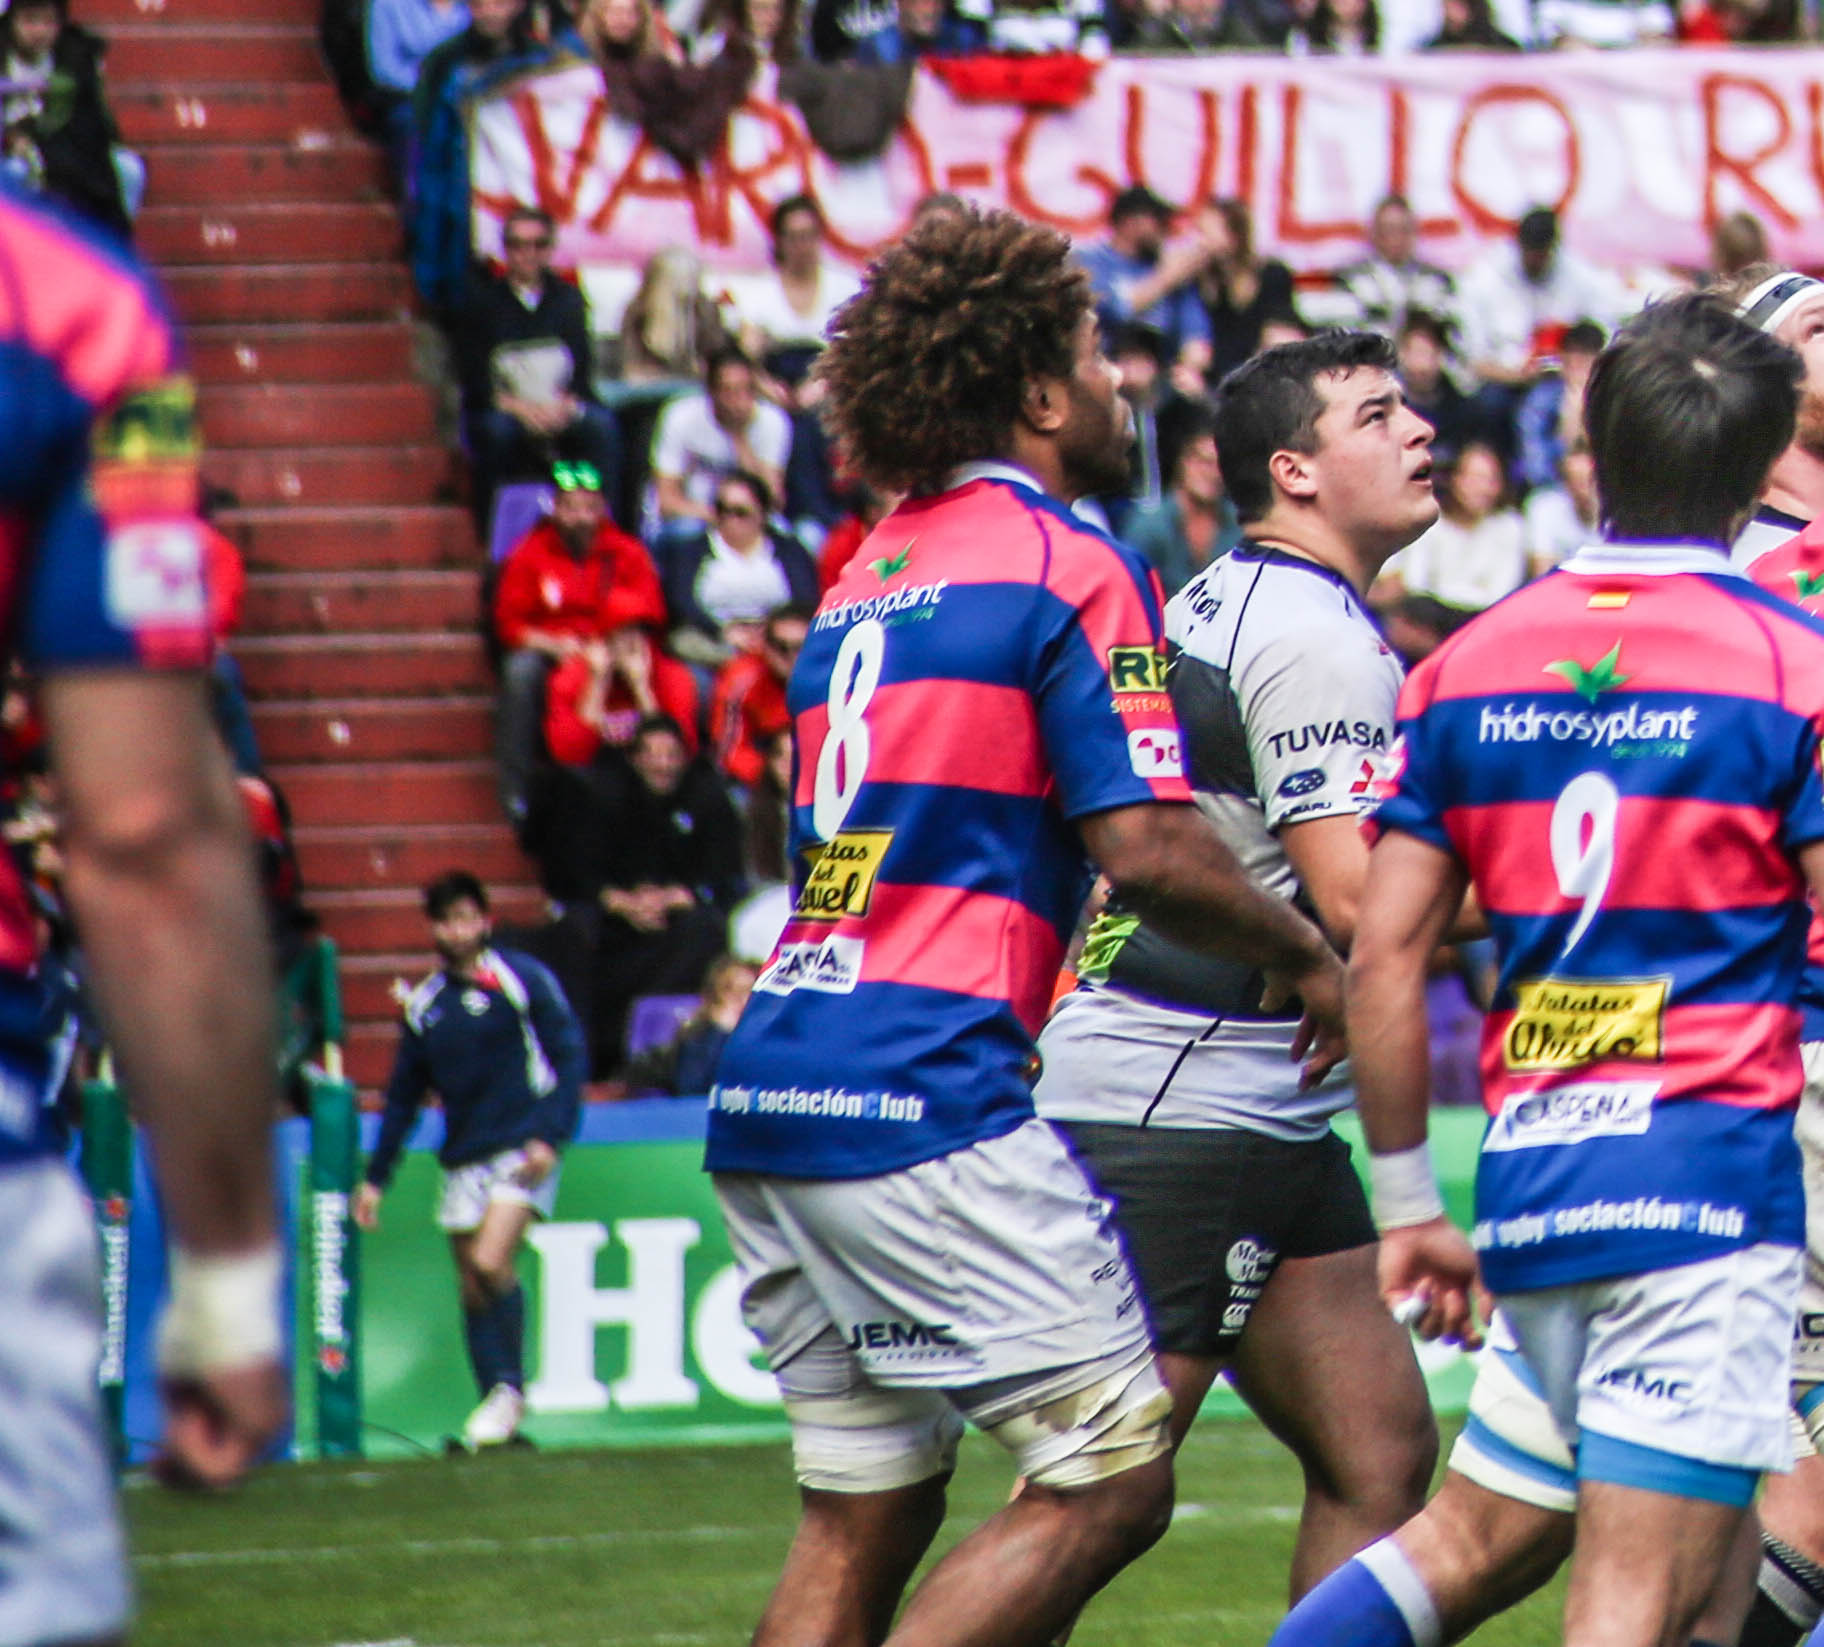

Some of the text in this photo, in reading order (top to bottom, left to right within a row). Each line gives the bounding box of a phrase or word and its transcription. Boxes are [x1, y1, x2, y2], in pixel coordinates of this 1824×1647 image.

[813, 578, 951, 633] hidrosyplant
[813, 620, 885, 842] 8
[1268, 720, 1387, 759] TUVASA
[1478, 702, 1700, 748] hidrosyplant
[1549, 771, 1620, 960] 9
